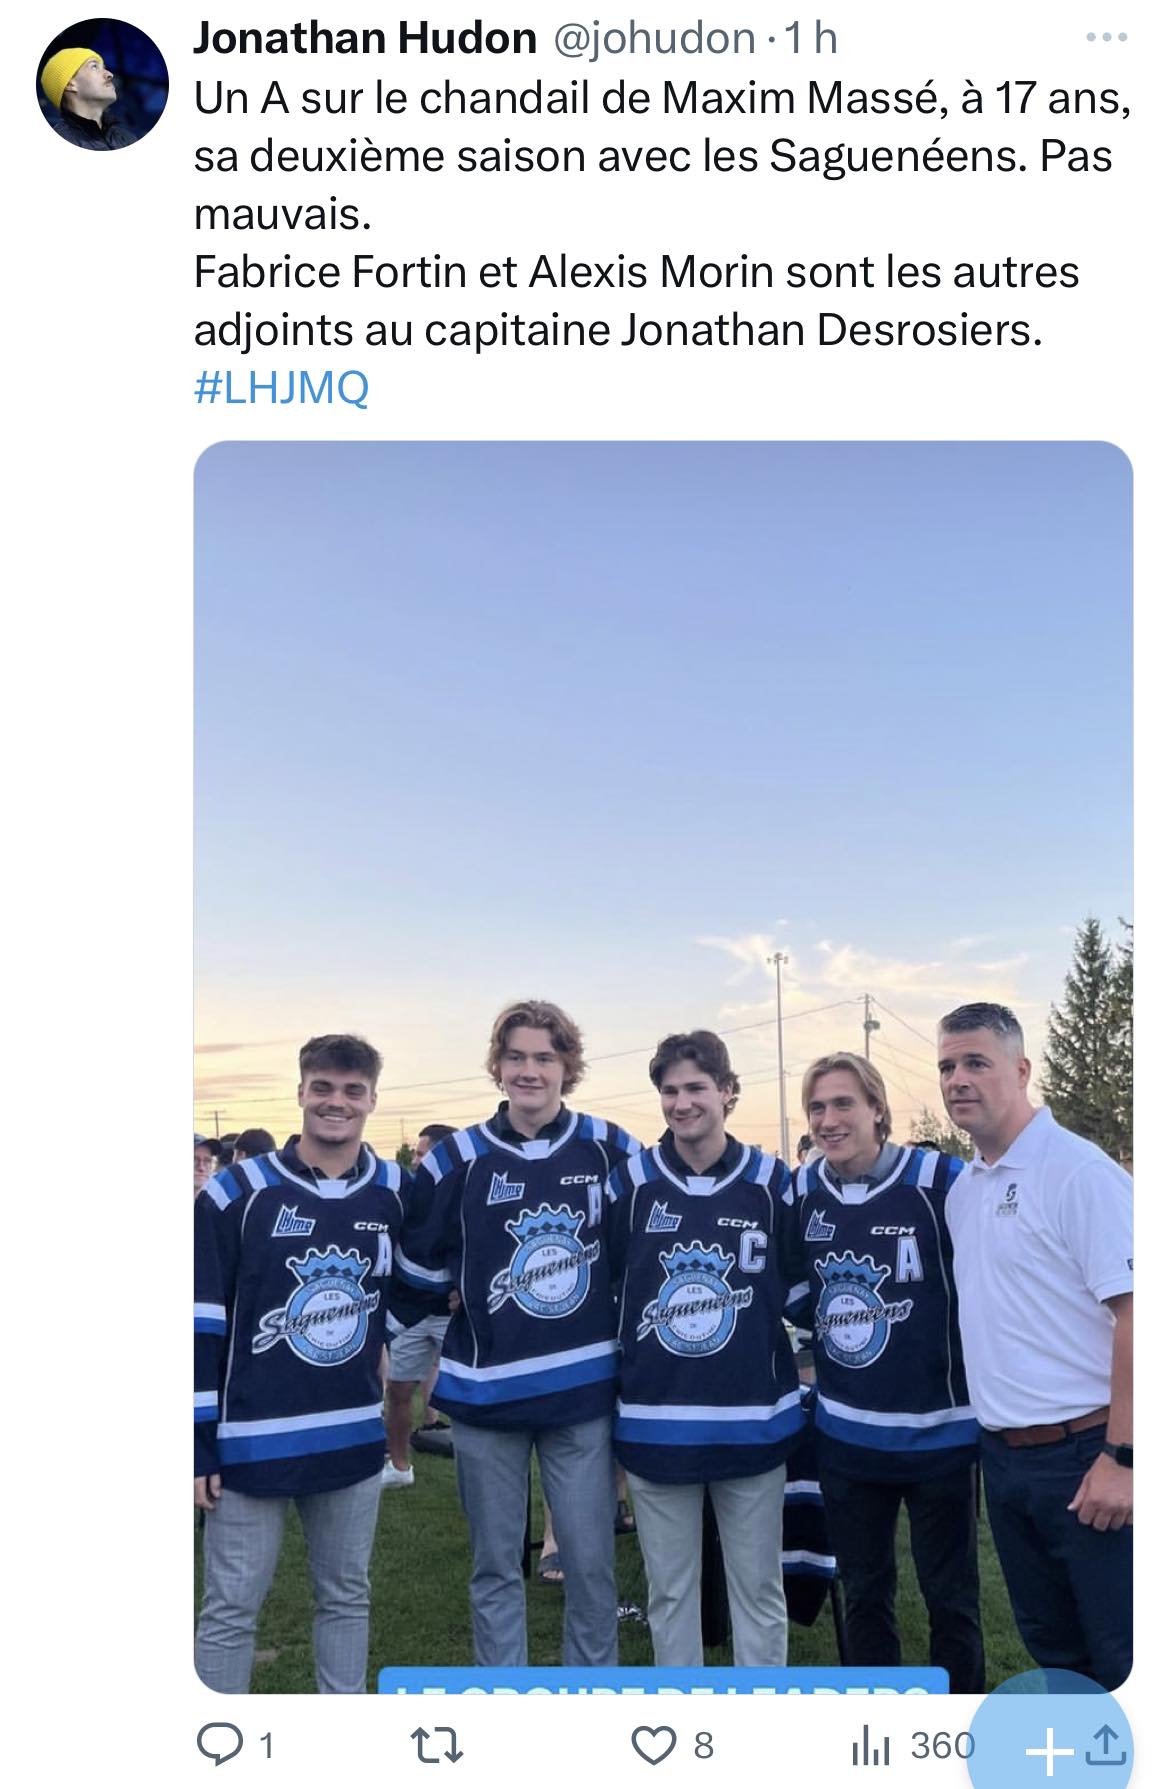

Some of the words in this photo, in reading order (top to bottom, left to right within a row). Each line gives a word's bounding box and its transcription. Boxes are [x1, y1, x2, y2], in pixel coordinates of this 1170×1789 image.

[193, 19, 385, 54] Jonathan
[400, 19, 536, 54] Hudon
[555, 19, 754, 62] @johudon
[786, 21, 798, 53] 1
[816, 19, 836, 53] h
[196, 81, 247, 114] Un
[260, 81, 289, 113] A
[302, 89, 363, 114] sur
[377, 79, 407, 114] le
[421, 79, 588, 114] chandail
[603, 79, 650, 114] de
[664, 80, 794, 114] Maxim
[809, 79, 947, 119] Massé,
[962, 79, 982, 114] à
[997, 81, 1037, 113] 17
[1049, 89, 1129, 119] ans,
[195, 147, 237, 172] sa
[251, 137, 444, 172] deuxième
[458, 138, 584, 172] saison
[599, 147, 690, 172] avec
[705, 137, 758, 172] les
[771, 137, 1026, 180] Saguenéens.
[1042, 139, 1112, 172] Pas
[196, 196, 370, 230] mauvais.
[196, 253, 340, 288] Fabrice
[354, 254, 465, 288] Fortin
[480, 257, 517, 288] et
[528, 253, 647, 288] Alexis
[662, 254, 772, 288] Morin
[787, 257, 874, 288] sont
[888, 253, 941, 288] les
[954, 257, 1079, 288] autres
[195, 311, 353, 354] adjoints
[366, 321, 411, 346] au
[426, 312, 610, 354] capitaine
[621, 311, 803, 346] Jonathan
[819, 312, 1041, 346] Desrosiers.
[194, 370, 368, 409] #LHJMQ
[560, 1174, 599, 1185] CCM
[353, 1221, 389, 1233] CCM
[717, 1217, 758, 1229] CCM
[870, 1226, 916, 1235] CCM
[372, 1232, 393, 1277] A
[541, 1248, 557, 1257] LES
[738, 1230, 768, 1273] C
[895, 1236, 924, 1283] A
[324, 1293, 340, 1301] LES
[687, 1287, 702, 1295] LES
[260, 1732, 271, 1758] 1
[695, 1732, 713, 1759] 8
[912, 1731, 975, 1759] 360
